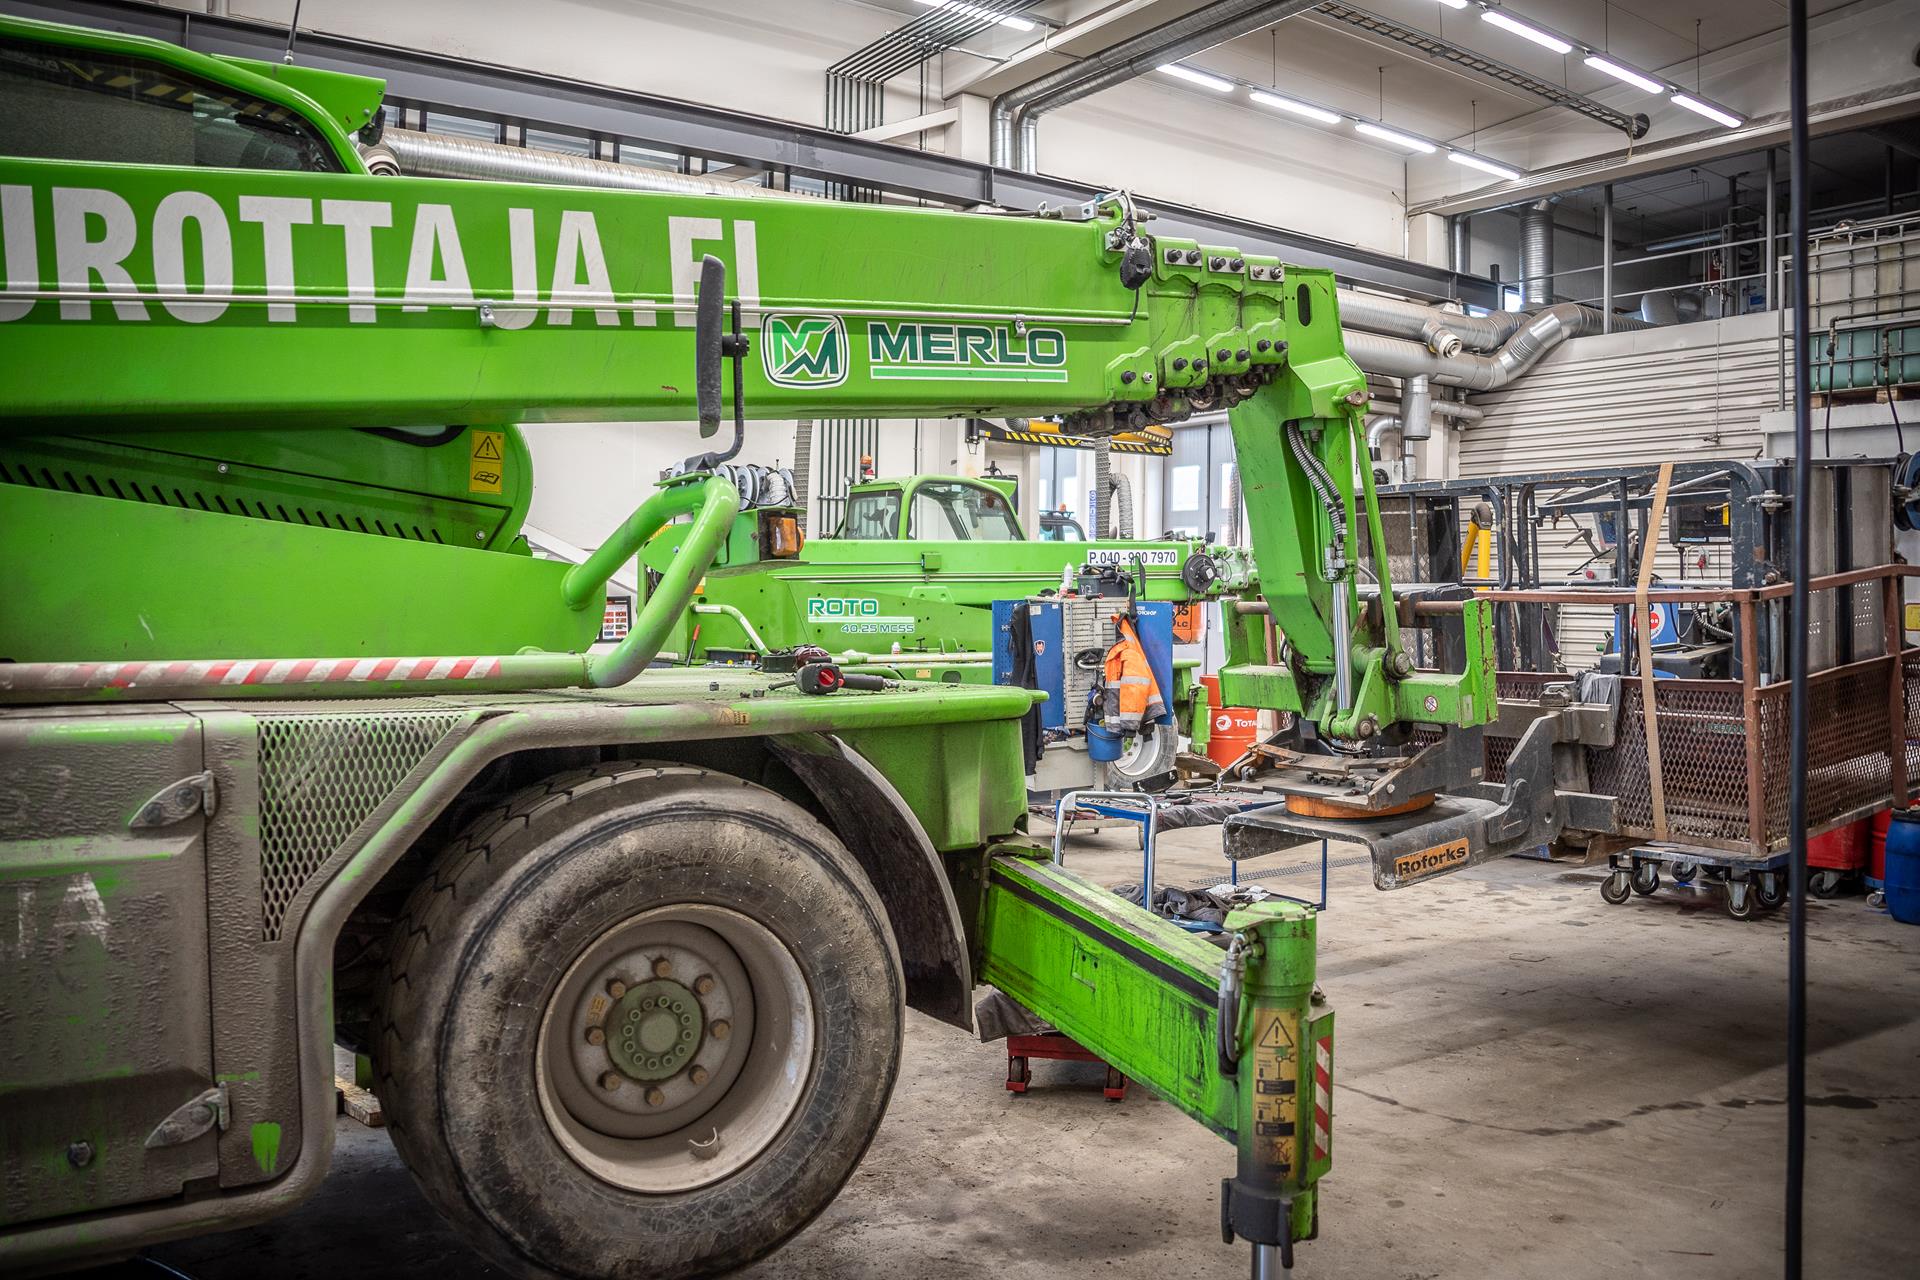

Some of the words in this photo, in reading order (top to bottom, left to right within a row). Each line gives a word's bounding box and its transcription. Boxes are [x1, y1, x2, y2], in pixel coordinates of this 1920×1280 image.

[868, 322, 1066, 367] MERLO
[1151, 551, 1176, 564] 7970
[808, 598, 878, 616] ROTO
[841, 624, 878, 633] 40.25
[880, 624, 915, 633] MCSS
[1397, 846, 1466, 877] Roforks
